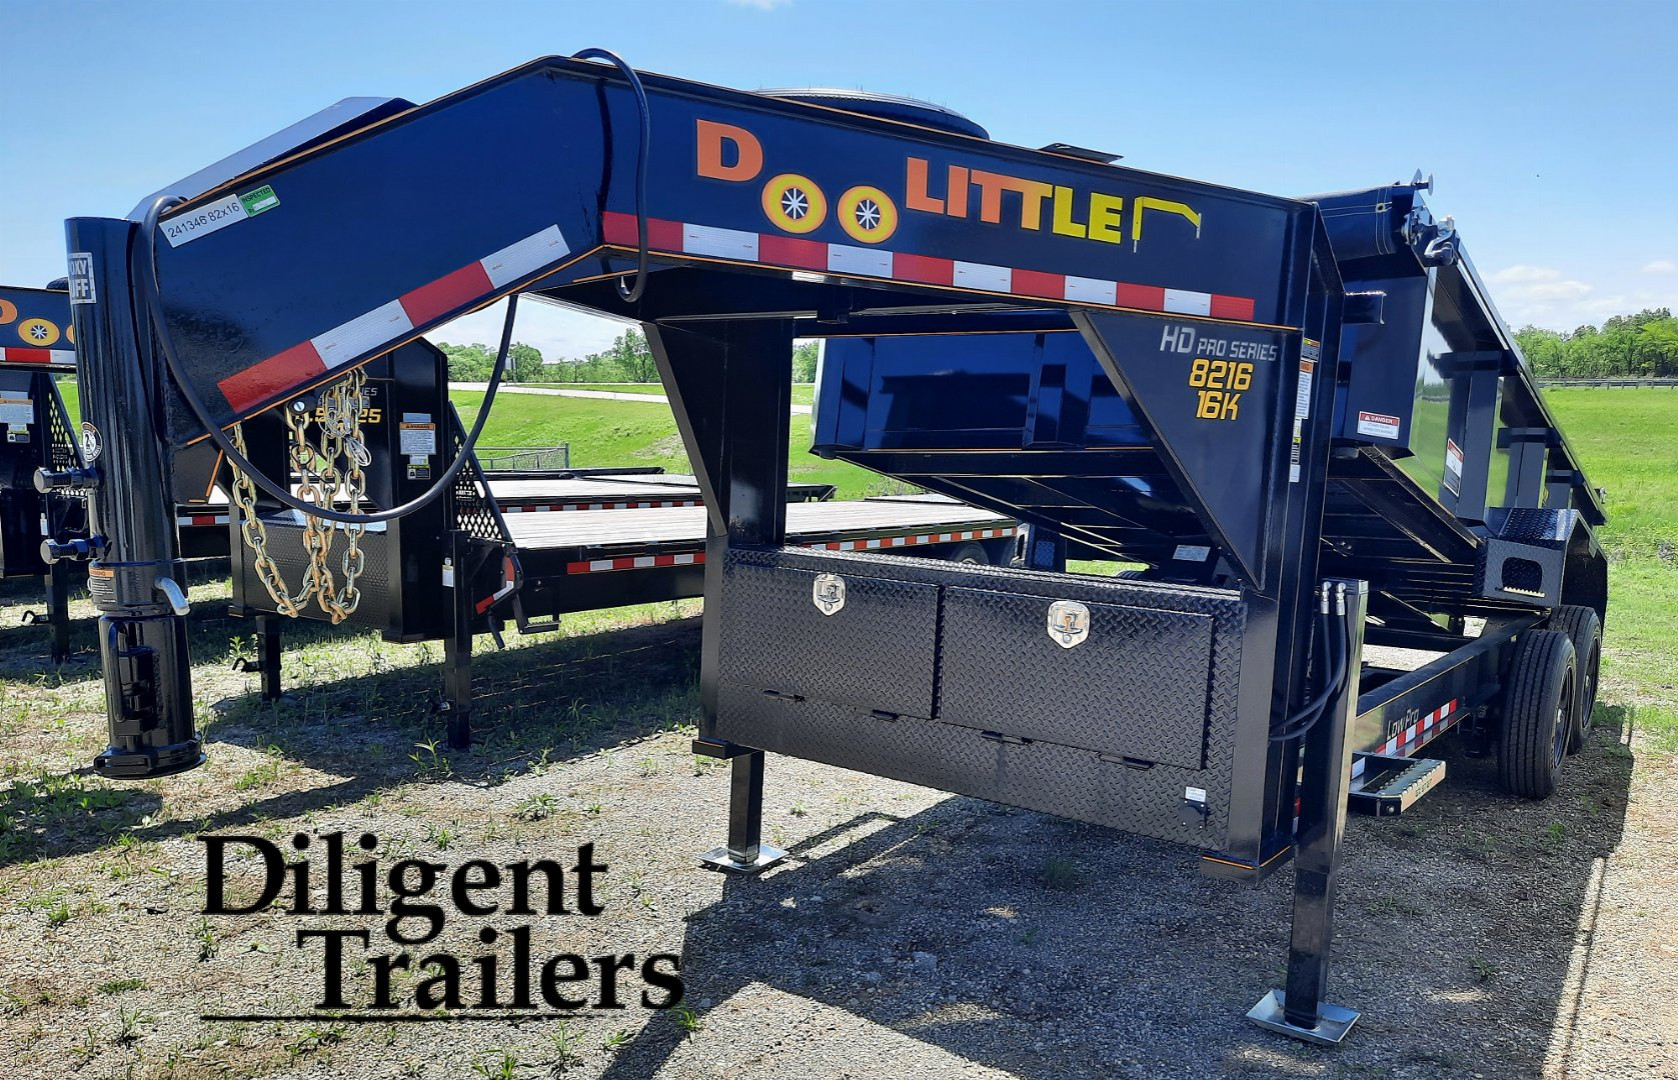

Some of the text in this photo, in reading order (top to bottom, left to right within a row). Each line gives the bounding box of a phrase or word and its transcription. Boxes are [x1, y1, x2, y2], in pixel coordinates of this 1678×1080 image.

[242, 187, 271, 202] INSPECTED
[167, 202, 240, 238] 241346 82x16
[1160, 325, 1196, 353] HD
[1196, 338, 1227, 356] PRO
[1229, 341, 1279, 361] SERIES
[1188, 358, 1254, 391] 8216
[1196, 390, 1242, 421] 16K
[1370, 416, 1393, 424] DANGER
